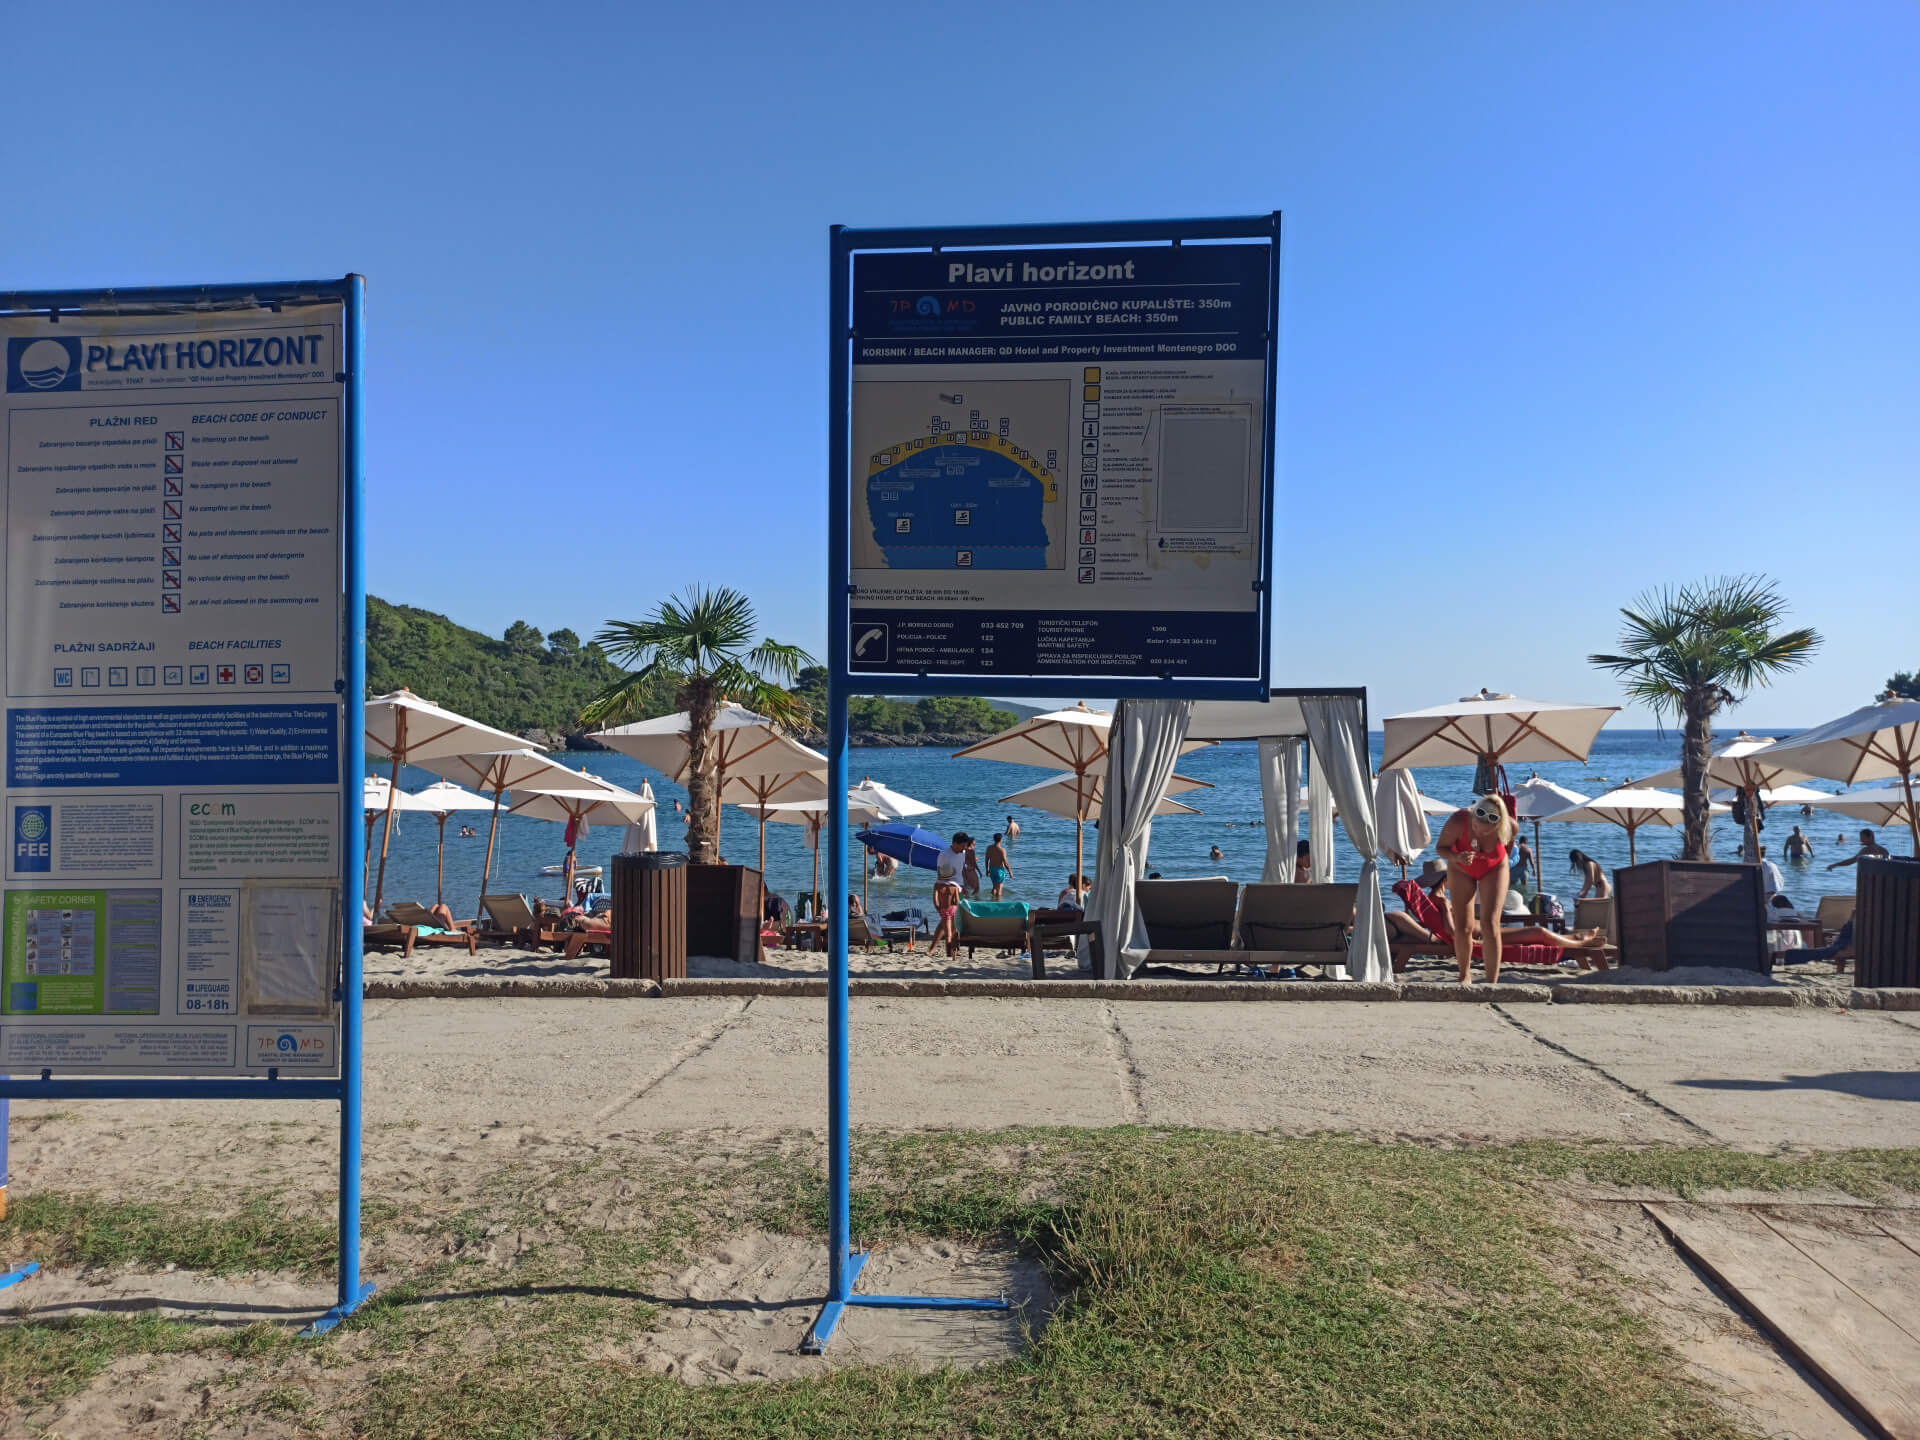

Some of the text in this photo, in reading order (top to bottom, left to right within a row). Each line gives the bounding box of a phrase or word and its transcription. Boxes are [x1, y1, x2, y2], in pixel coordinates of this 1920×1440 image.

[948, 260, 1135, 283] Plavi horizont
[1001, 298, 1232, 313] JAVNO PORODIČNO KUPALIŠTE: 350m
[1001, 313, 1179, 325] PUBLIC FAMILY BEACH: 350m
[86, 334, 324, 372] PLAVI HORIZONT
[862, 347, 907, 356] KORISNIK
[914, 346, 945, 356] BEACH
[947, 346, 996, 355] MANAGER:
[1015, 345, 1040, 354] Hotel
[1042, 346, 1059, 354] and
[1061, 344, 1101, 355] Property
[1103, 344, 1155, 353] Investment
[1157, 343, 1213, 355] Montenegro
[1215, 343, 1237, 351] DOO
[89, 415, 158, 428] PLAŽNI RED
[192, 410, 328, 424] BEACH CODE OF CONDUCT
[257, 597, 269, 605] the
[54, 642, 95, 653] PLAŽNI
[188, 639, 282, 651] BEACH FACILITIES
[57, 672, 70, 685] WC
[17, 843, 49, 857] FEE
[23, 895, 96, 905] SAFETY CORNER
[195, 984, 230, 992] LIFEGUARD
[186, 999, 229, 1010] 08-18h
